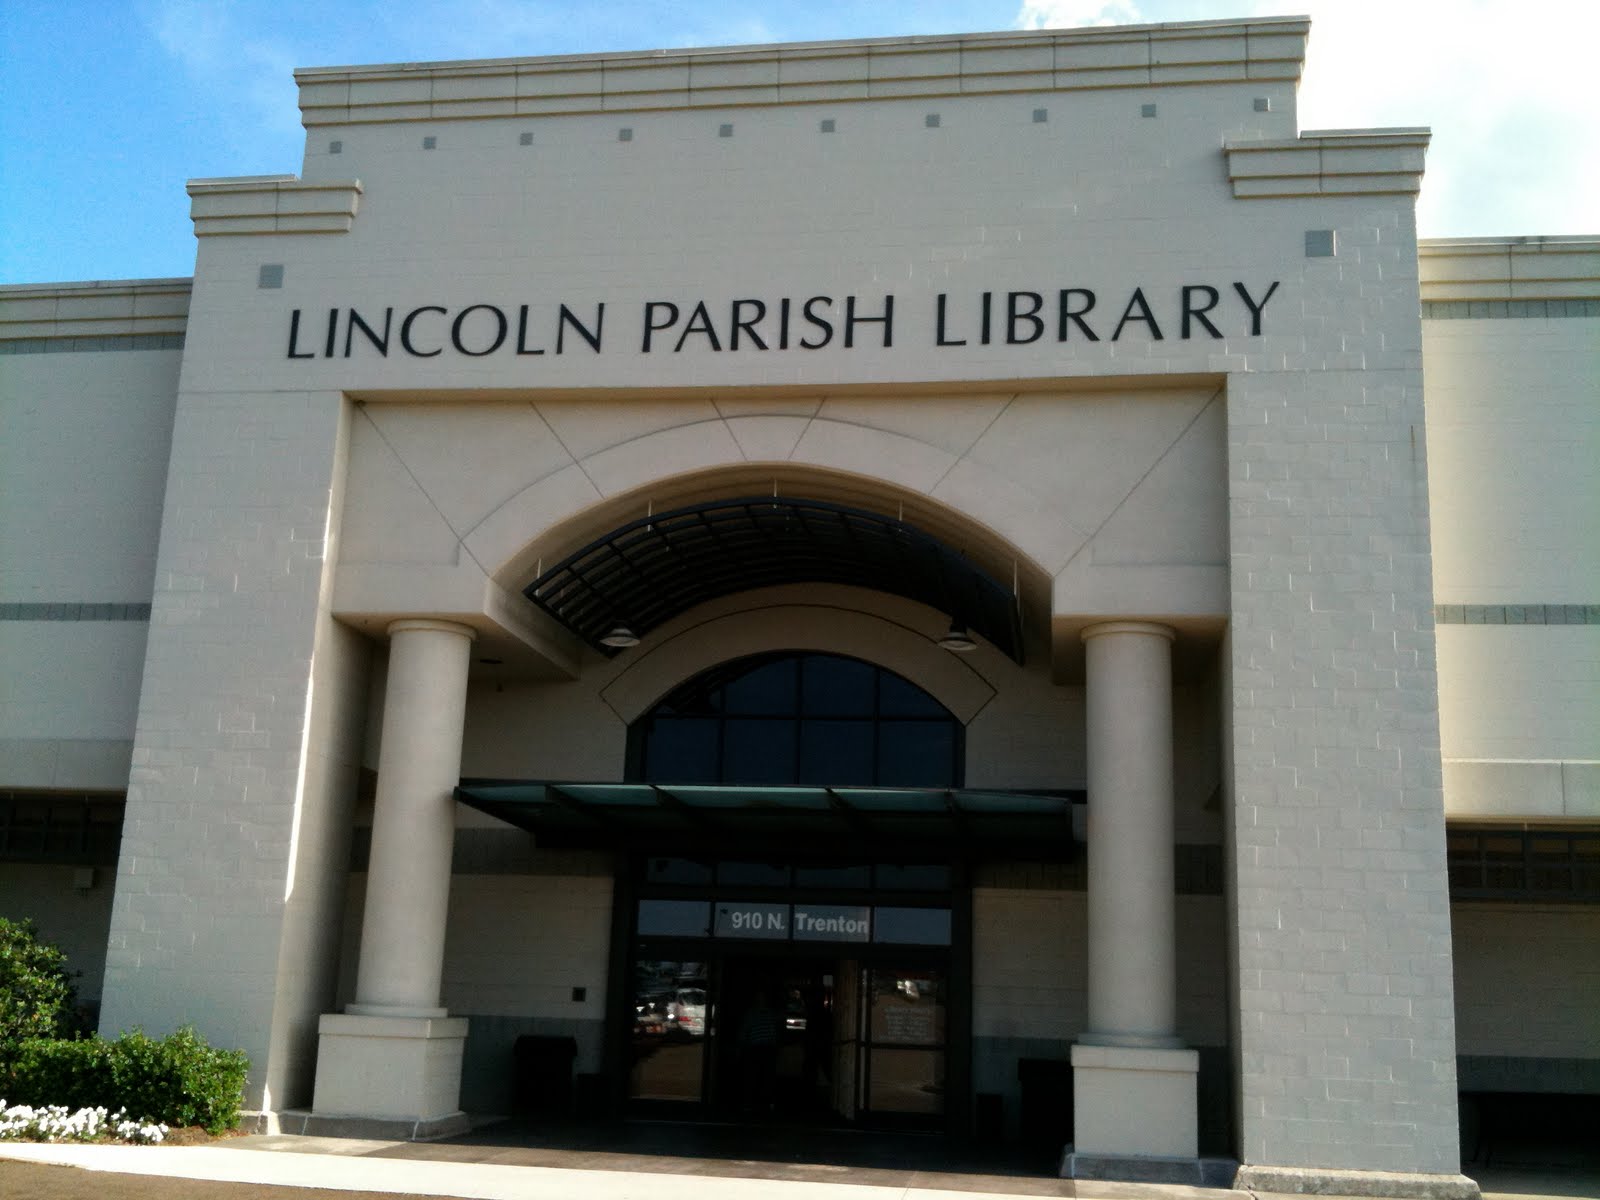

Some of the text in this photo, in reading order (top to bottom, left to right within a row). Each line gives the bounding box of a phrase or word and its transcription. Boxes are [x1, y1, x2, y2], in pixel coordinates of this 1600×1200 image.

[287, 281, 1281, 358] LINCOLN PARISH LIBRARY
[731, 911, 868, 934] 910 N. Trenton
